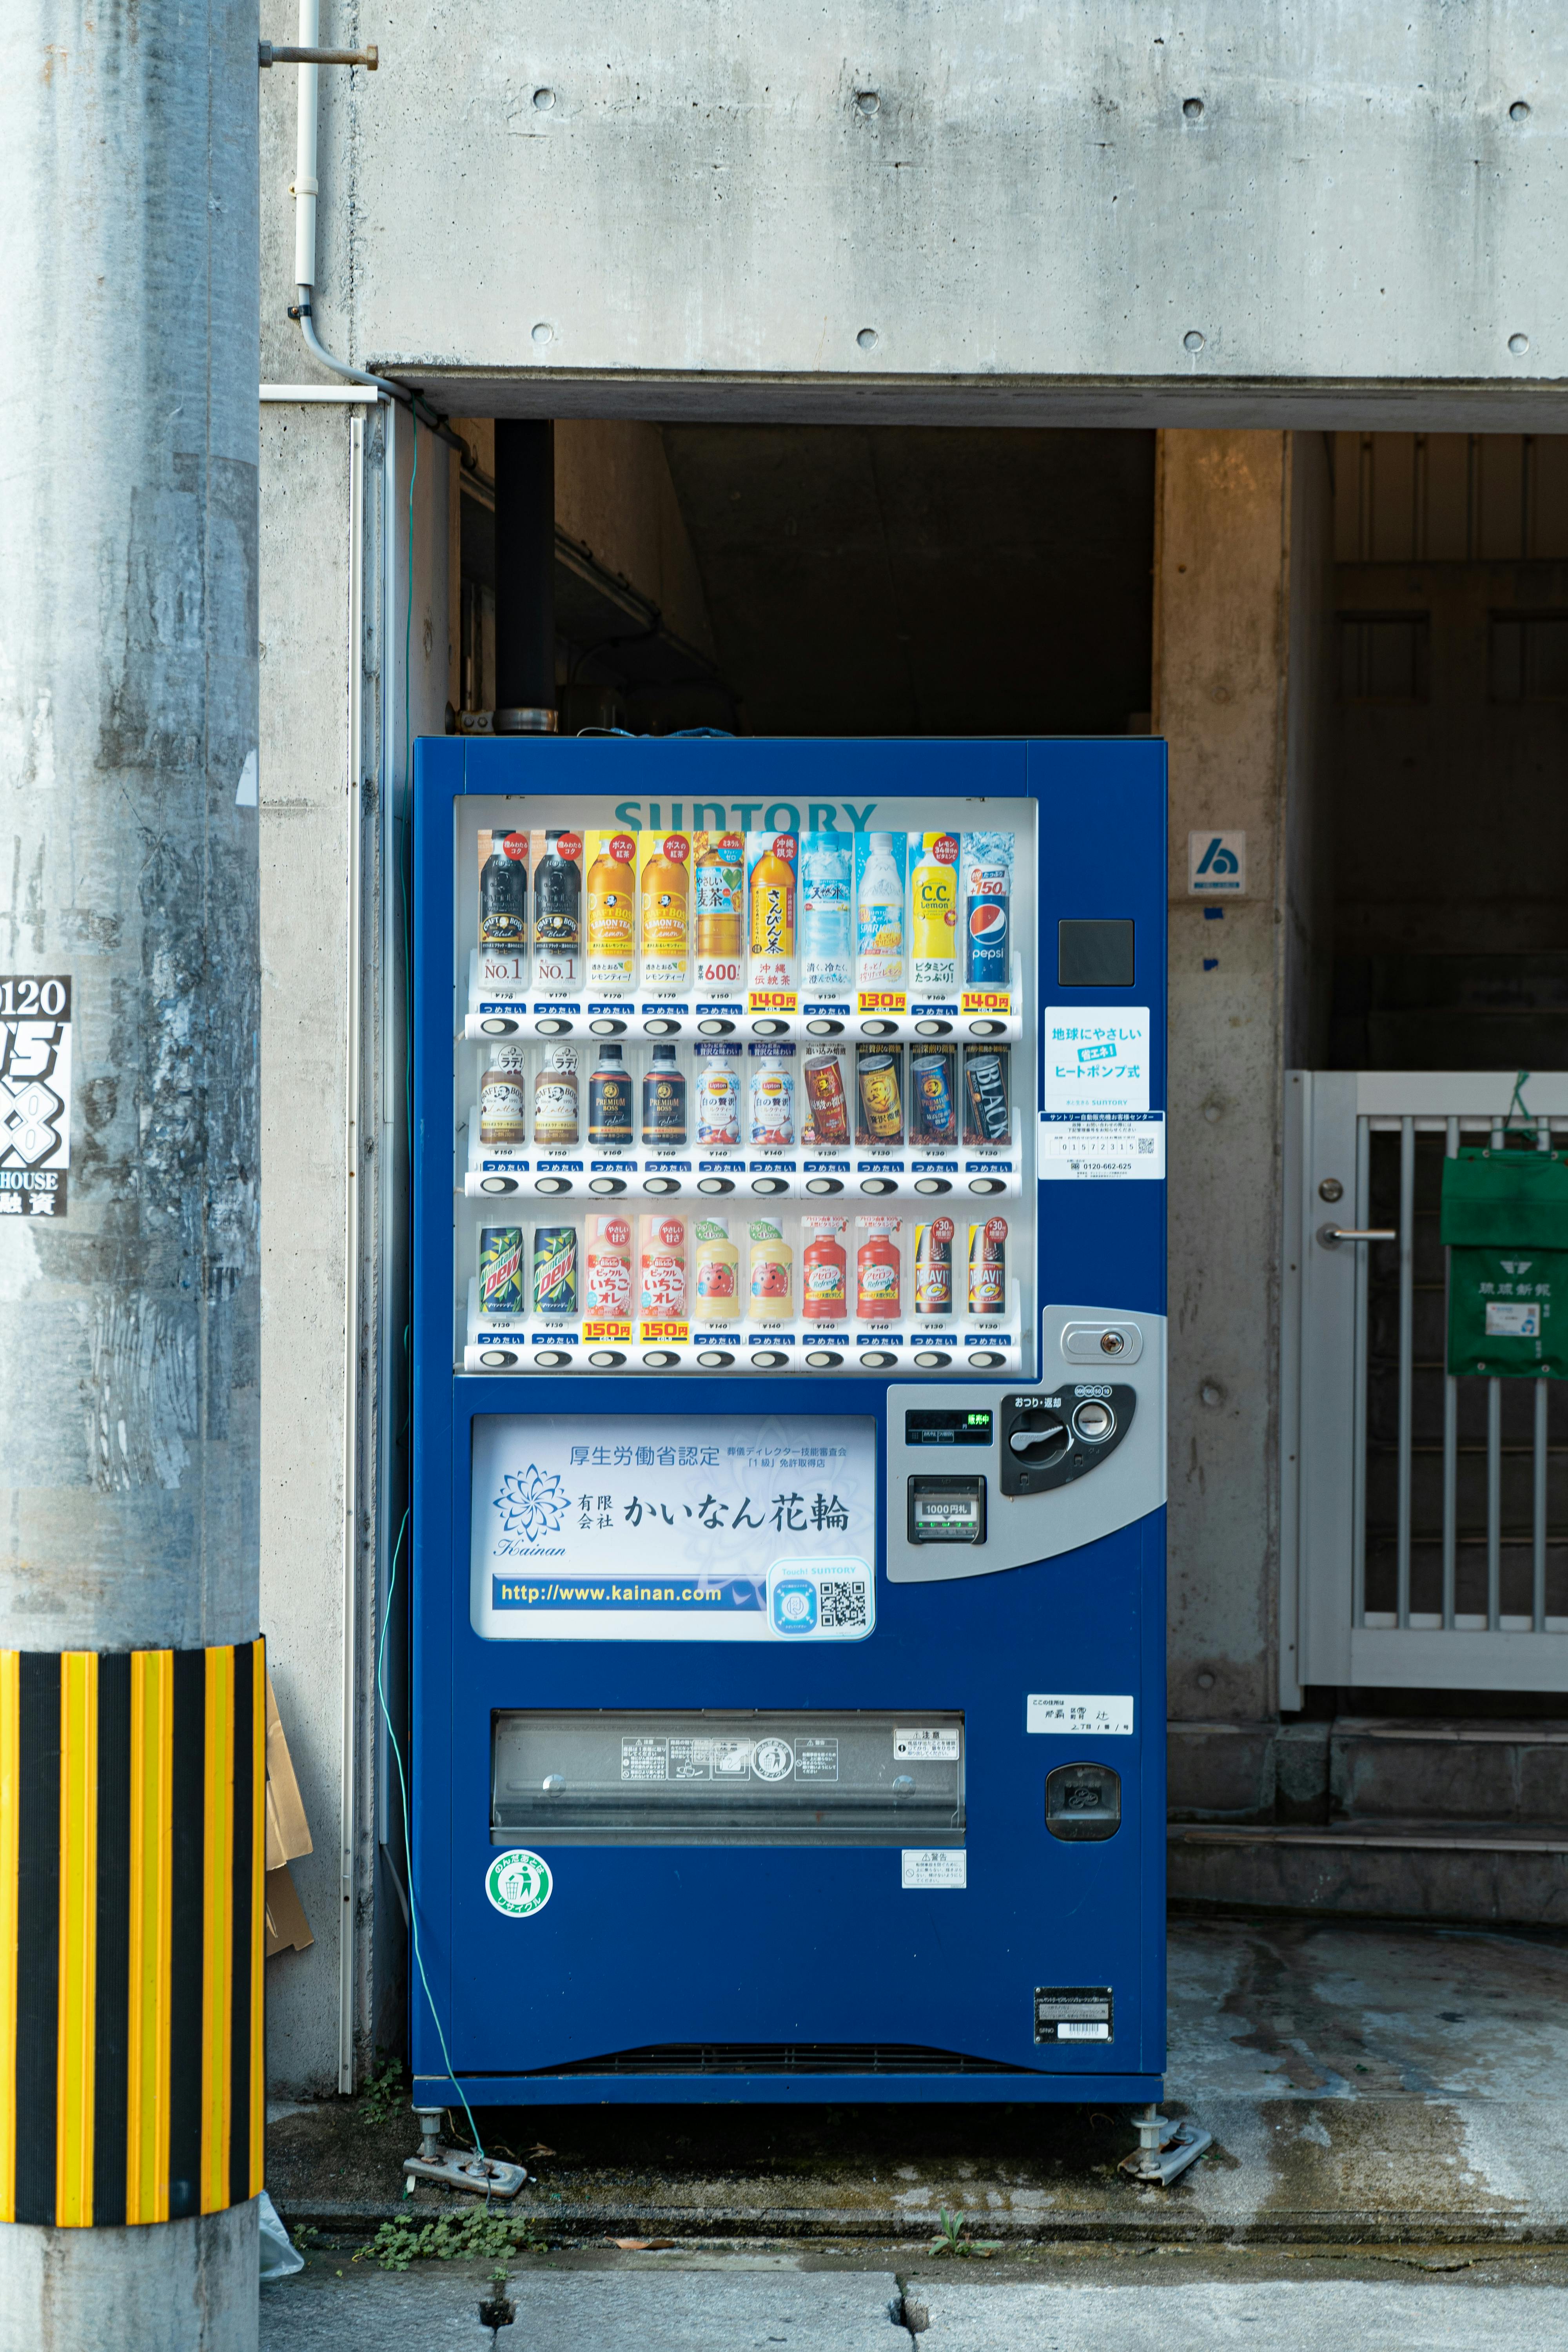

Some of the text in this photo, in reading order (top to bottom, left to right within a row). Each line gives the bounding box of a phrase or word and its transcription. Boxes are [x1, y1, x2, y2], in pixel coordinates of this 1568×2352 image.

[614, 802, 877, 833] SUNTORY
[612, 840, 632, 849] ボスの
[666, 840, 686, 850] ボスの
[777, 838, 794, 849] 沖縄
[616, 850, 630, 858] 紅茶
[670, 850, 684, 858] 紅茶
[777, 849, 794, 858] 限定
[697, 876, 722, 887] やさしい
[697, 887, 723, 907] 麦茶
[811, 886, 845, 899] 天然水
[922, 886, 950, 902] C.C.
[483, 917, 523, 931] CRAFT BOSS
[537, 917, 577, 931] CRAFT BOSS
[591, 919, 631, 930] LEMON TEA
[645, 919, 685, 930] LEMON TEA
[764, 889, 784, 955] さんぴん茶
[598, 928, 625, 938] Lemon
[652, 928, 679, 938] Lemon
[972, 948, 1004, 960] pepsi
[759, 963, 786, 975] 沖縄
[916, 962, 954, 972] ビタミンC
[755, 975, 791, 986] 伝統茶
[915, 973, 954, 983] たっぷり!
[0, 979, 66, 1015] 120
[750, 993, 796, 1007] 140円
[859, 994, 905, 1007] 130円
[963, 994, 1009, 1008] 140円
[1052, 1027, 1142, 1041] 地球にやさしい
[806, 1047, 846, 1056] 追い込み焙煎
[1081, 1045, 1114, 1061] 省エネ!
[501, 1057, 523, 1068] ラテ!
[555, 1058, 577, 1069] ラテ!
[1055, 1064, 1140, 1078] ヒートポンプ式
[596, 1098, 625, 1107] PREMIUM
[650, 1098, 679, 1107] PREMIUM
[702, 1097, 735, 1106] 白の贅沢
[757, 1097, 789, 1106] 白の贅沢
[976, 1064, 1009, 1139] BLACK
[611, 1234, 626, 1243] 甘さ
[665, 1234, 680, 1243] 甘さ
[596, 1269, 623, 1277] ビックル
[650, 1269, 677, 1277] ビックル
[810, 1272, 838, 1281] アセロラ
[864, 1272, 892, 1281] アセロラ
[590, 1278, 630, 1291] いちご
[644, 1278, 684, 1291] いちご
[813, 1279, 837, 1288] Refresh
[867, 1279, 891, 1288] Refresh
[916, 1269, 950, 1290] DEKAVIT
[926, 1283, 943, 1297] C
[979, 1283, 996, 1297] C
[598, 1292, 621, 1304] オレ
[652, 1292, 675, 1304] オレ
[585, 1323, 630, 1336] 150円
[643, 1323, 688, 1336] 150円
[1015, 1397, 1062, 1408] おつり・返却
[968, 1414, 989, 1425] 販売中
[570, 1446, 720, 1466] 厚生労働省認定
[727, 1446, 847, 1457] 葬儀ディレクター技能審査会
[577, 1494, 614, 1511] 有限
[623, 1492, 850, 1532] かいなん花輪
[926, 1504, 967, 1514] 1000円札
[577, 1513, 614, 1530] 会社
[493, 1538, 566, 1556] Kainan
[502, 1584, 721, 1603] http://www.kainan.com
[922, 1731, 940, 1739] 注意
[757, 1740, 789, 1754] のんだあとは
[759, 1767, 786, 1778] リサイクル
[931, 1853, 947, 1862] 警告
[495, 1854, 544, 1875] のんだあとは
[497, 1896, 541, 1913] リサイクル
